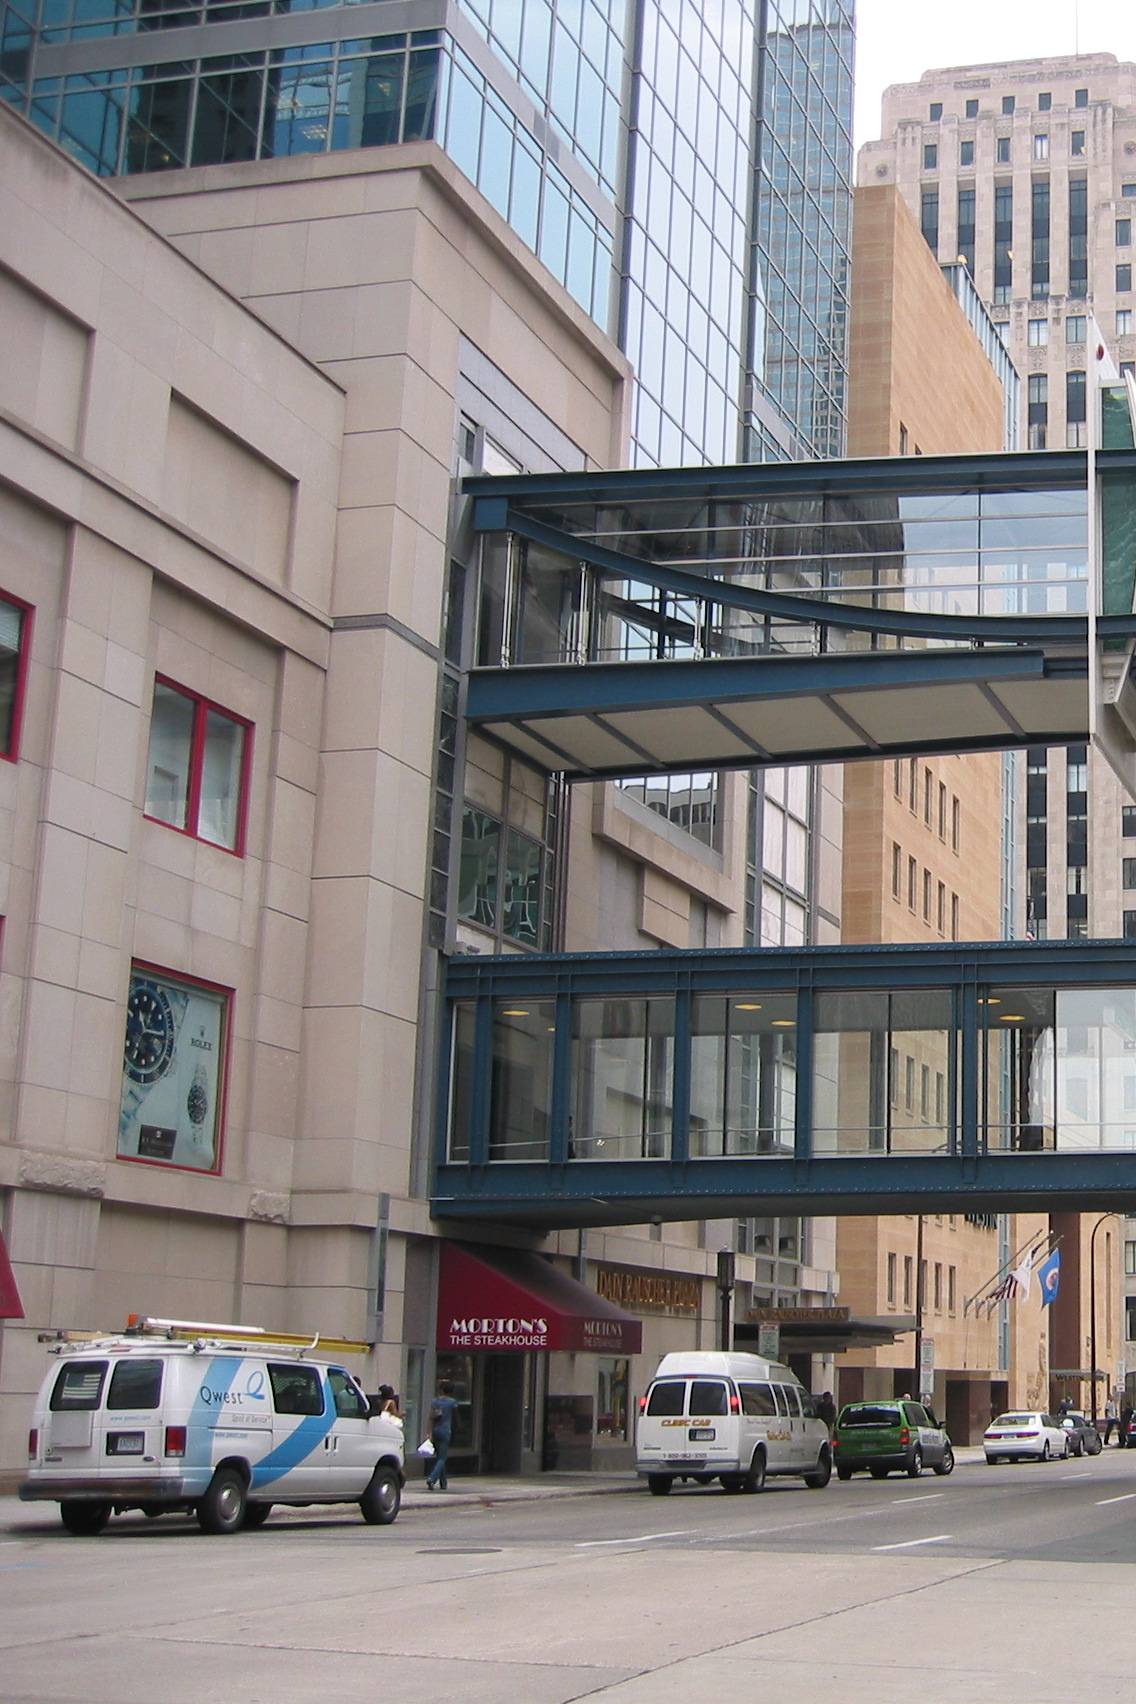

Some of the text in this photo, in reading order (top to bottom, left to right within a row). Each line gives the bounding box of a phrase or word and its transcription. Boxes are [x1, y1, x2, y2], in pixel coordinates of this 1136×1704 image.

[450, 1318, 548, 1334] MORTON'S
[450, 1335, 547, 1346] THE STEAKHOUSE
[200, 1386, 243, 1405] Qwest
